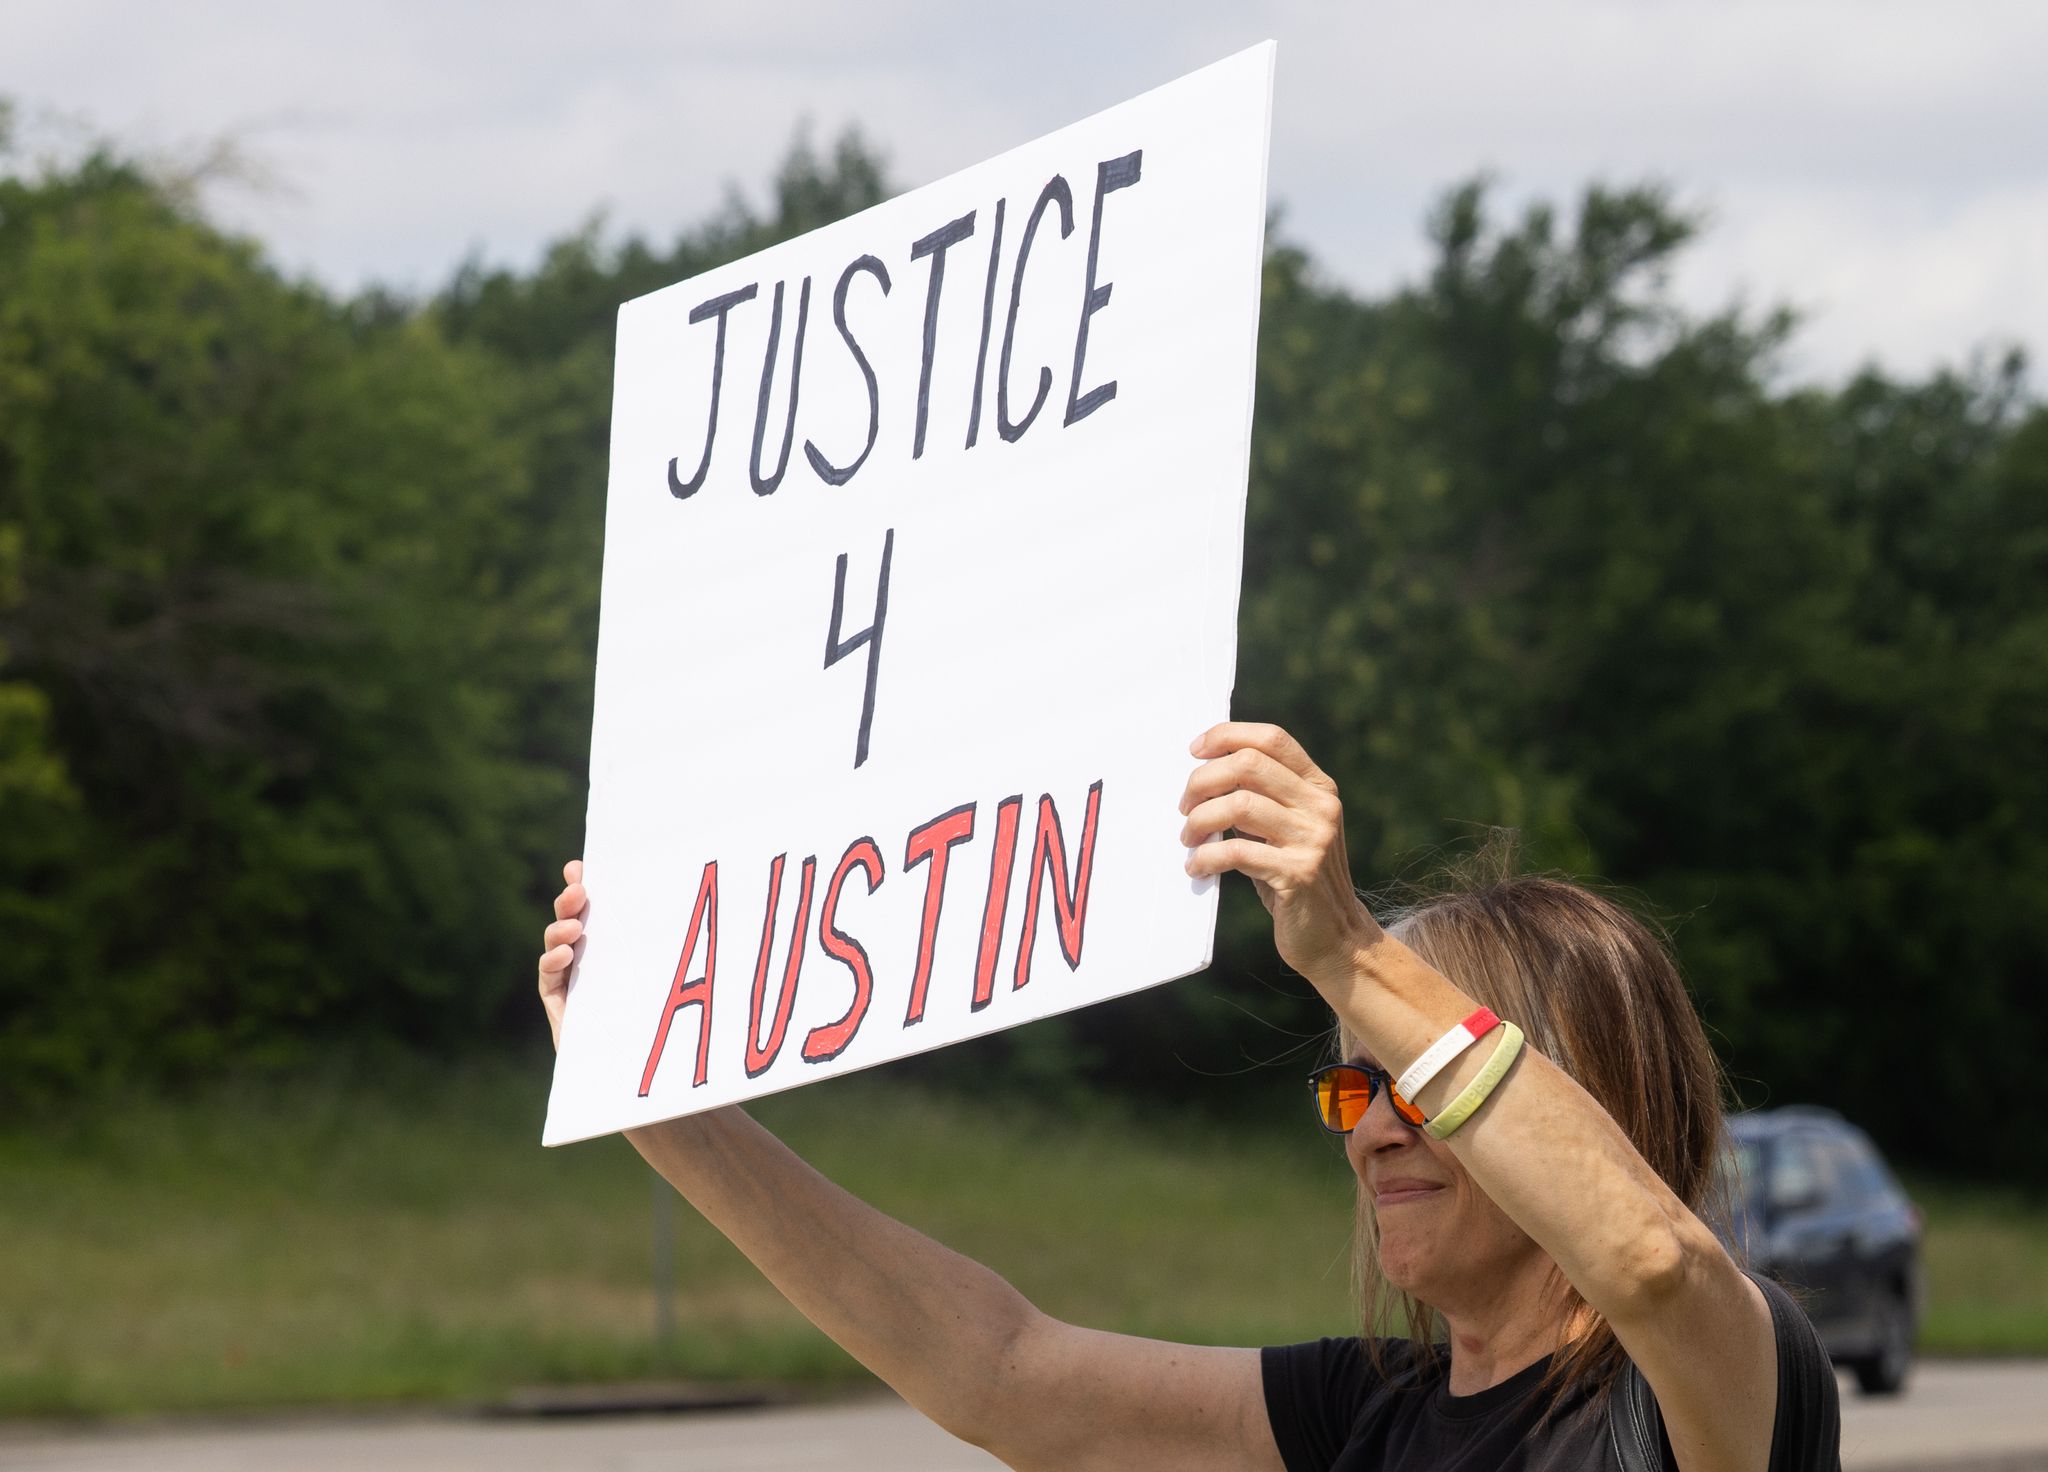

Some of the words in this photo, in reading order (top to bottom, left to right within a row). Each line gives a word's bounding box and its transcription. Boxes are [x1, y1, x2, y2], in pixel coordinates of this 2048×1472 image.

[667, 149, 1143, 500] JUSTICE
[823, 528, 894, 770] 4
[637, 778, 1104, 1098] AUSTIN
